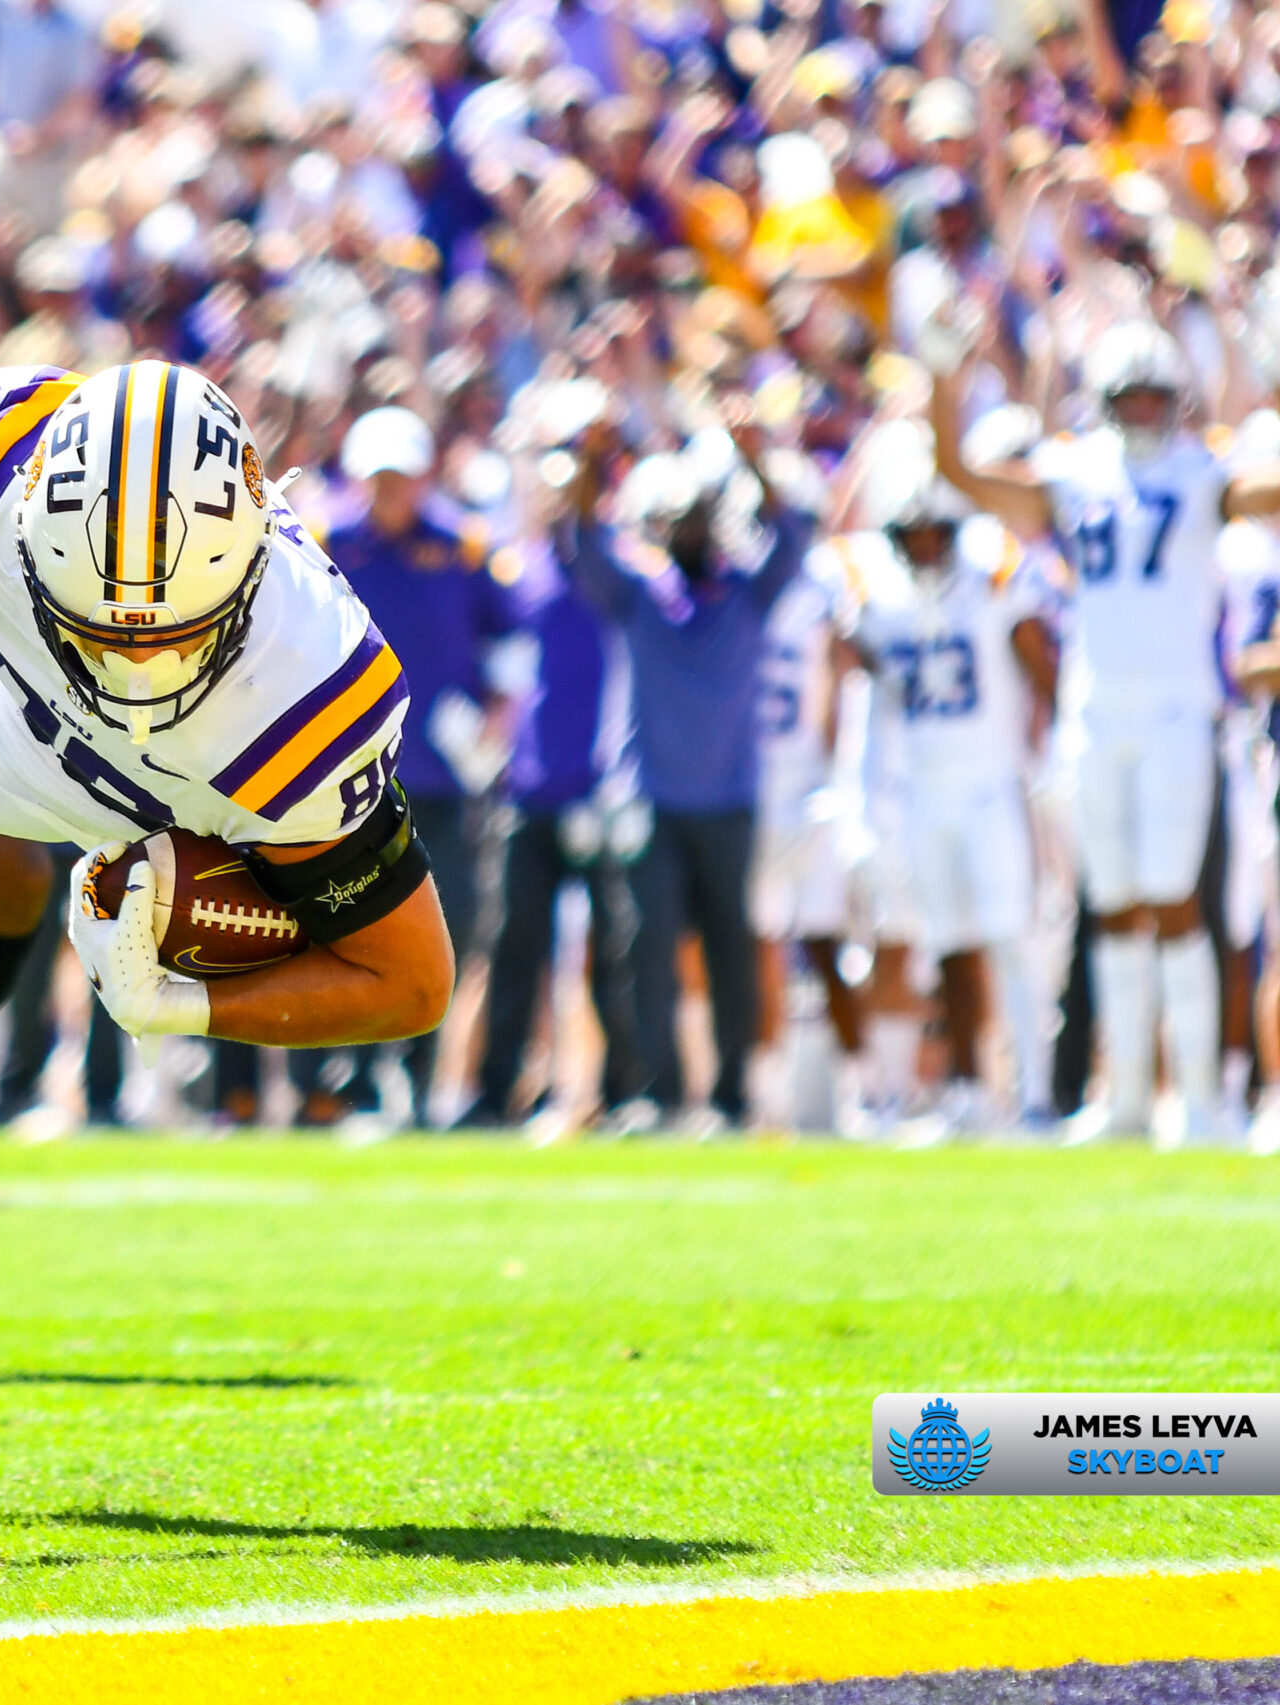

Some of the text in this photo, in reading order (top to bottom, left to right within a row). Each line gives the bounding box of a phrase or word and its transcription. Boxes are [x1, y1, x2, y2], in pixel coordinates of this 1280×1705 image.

[47, 392, 90, 514] SU
[111, 609, 156, 625] LSU
[333, 867, 381, 902] Douglas
